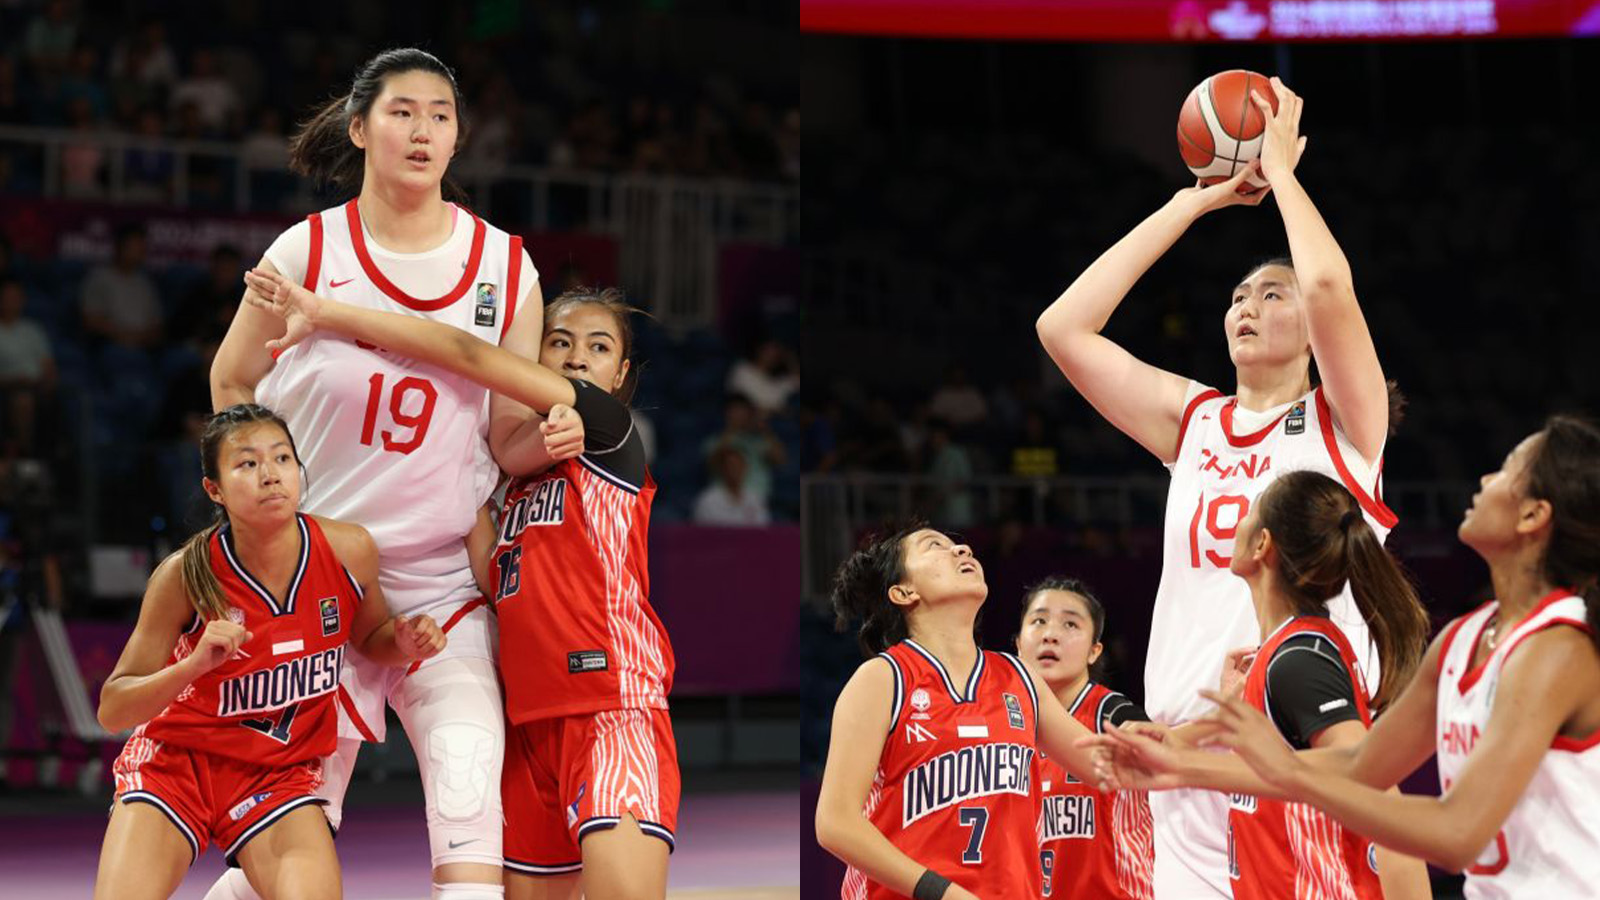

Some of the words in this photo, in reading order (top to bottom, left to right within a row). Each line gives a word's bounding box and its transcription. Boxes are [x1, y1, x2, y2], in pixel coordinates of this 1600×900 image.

[360, 372, 438, 456] 19
[1189, 490, 1251, 569] 19
[496, 543, 523, 604] 16
[218, 641, 348, 716] INDONESI
[903, 743, 1034, 830] INDONESIA
[958, 806, 989, 864] 7
[1039, 849, 1055, 898] 9
